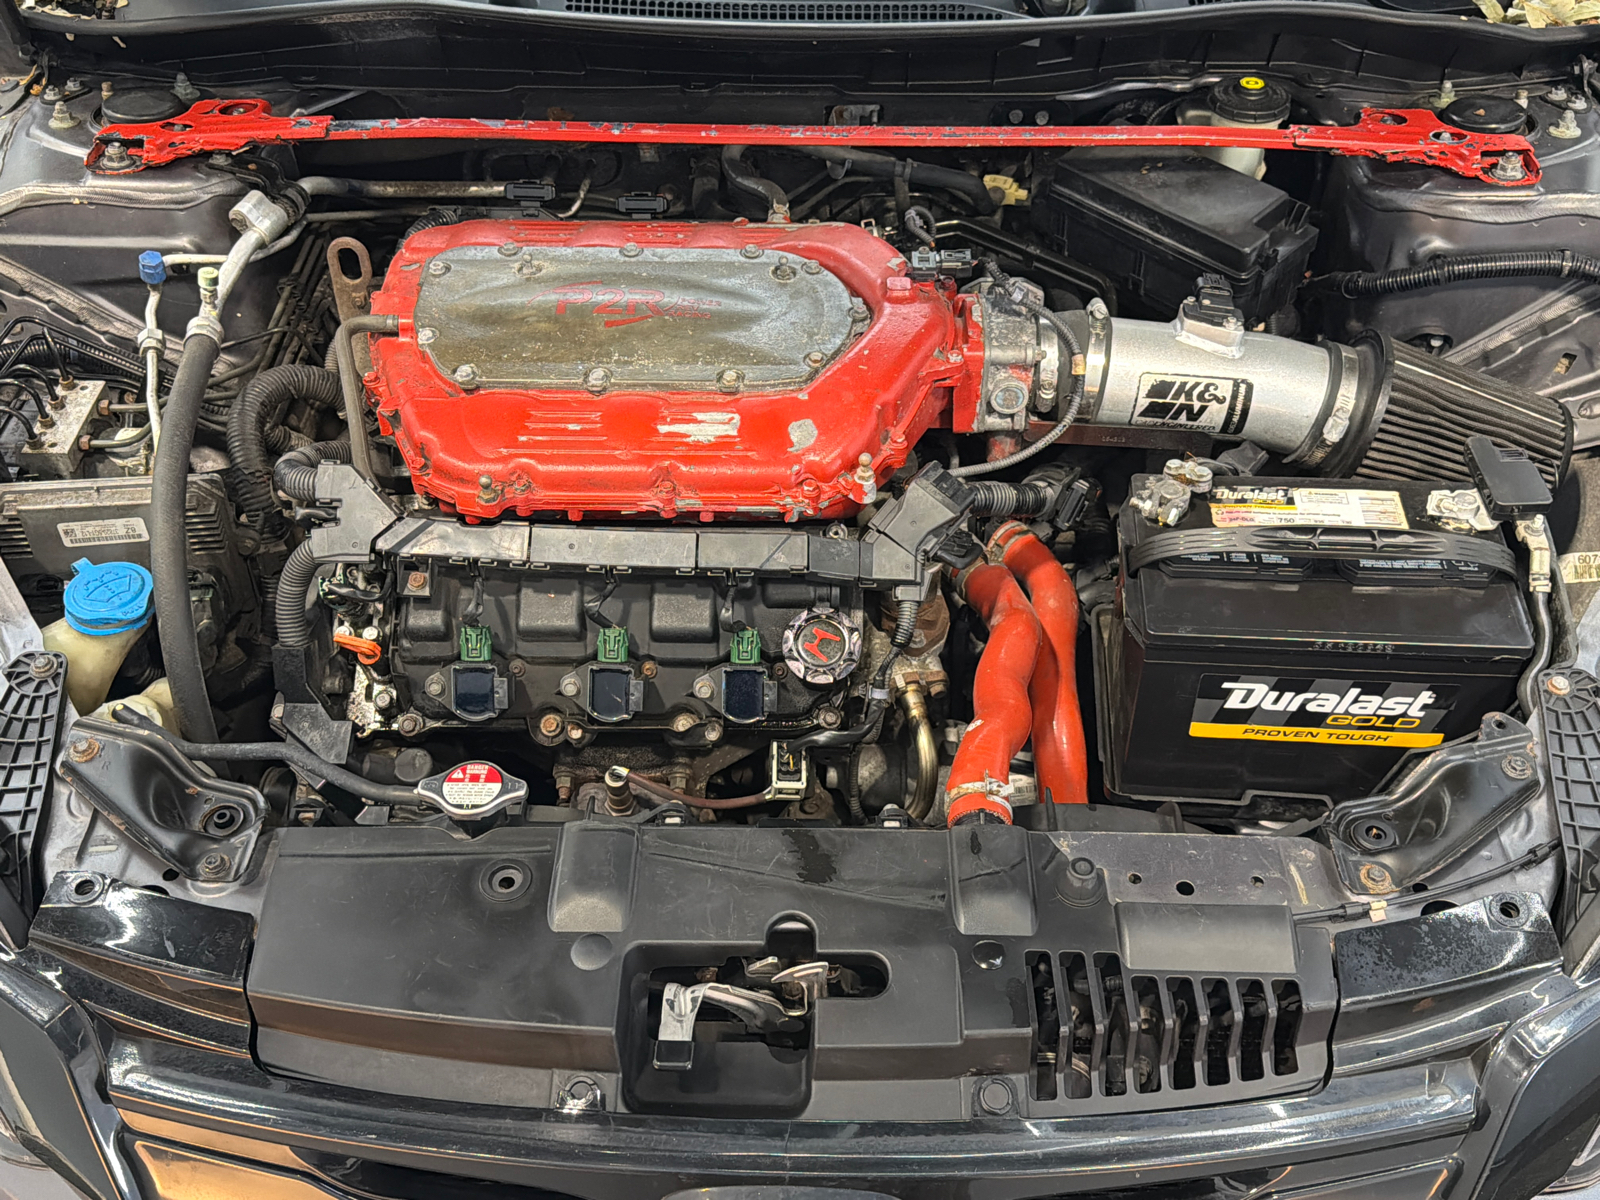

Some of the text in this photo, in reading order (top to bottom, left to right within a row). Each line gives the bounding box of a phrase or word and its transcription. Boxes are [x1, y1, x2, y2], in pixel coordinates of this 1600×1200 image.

[552, 288, 665, 316] P2R
[679, 298, 722, 306] POWER
[668, 311, 711, 319] RACING
[1232, 383, 1247, 424] ALUMINUM
[1153, 421, 1216, 431] ENGINEERED
[1212, 489, 1285, 500] Duralast
[1577, 554, 1600, 565] 607
[1221, 682, 1435, 717] Duralast
[1325, 715, 1421, 728] GOLD
[1242, 728, 1391, 742] PROVEN TOUGH
